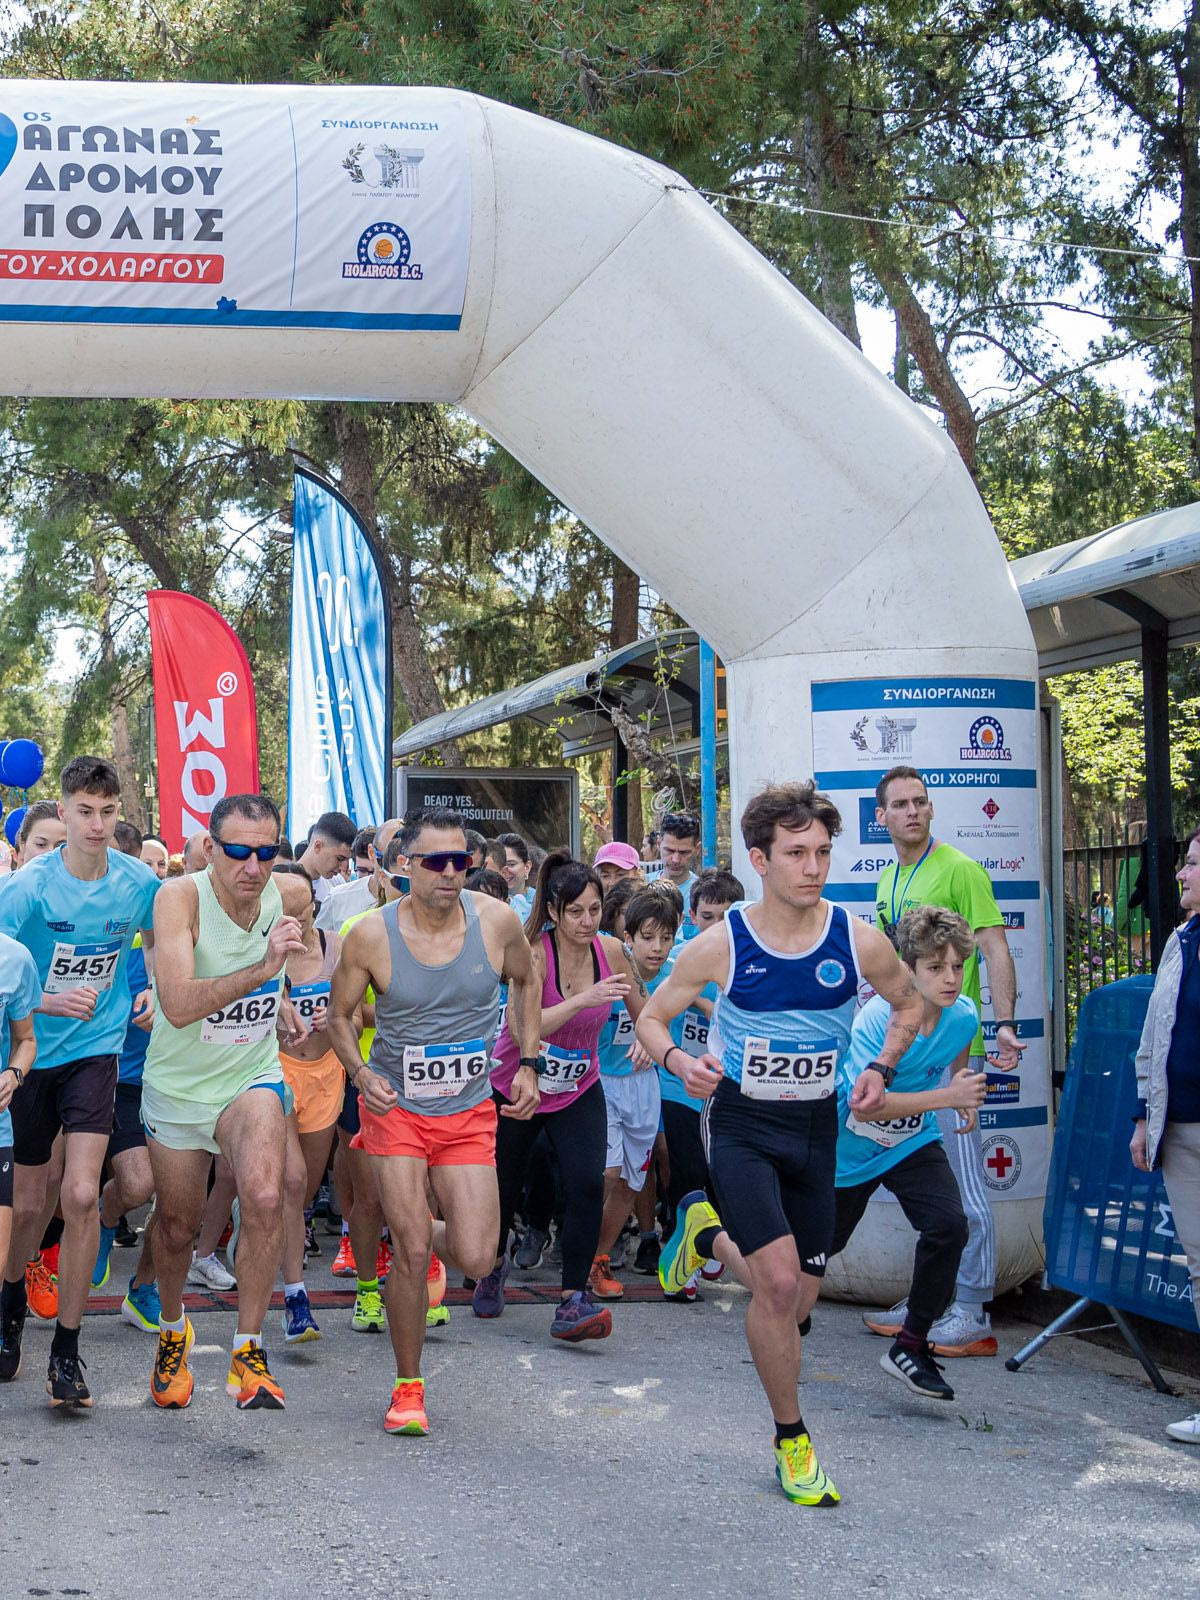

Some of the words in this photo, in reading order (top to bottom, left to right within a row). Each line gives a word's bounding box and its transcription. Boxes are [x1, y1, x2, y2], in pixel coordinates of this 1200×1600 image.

[321, 119, 439, 131] ΣΥΝΔΙΟΡΓΑΝΩΣΗ
[23, 124, 223, 156] ΑΓΩΝΑΣ
[24, 161, 223, 196] ΔΡΟΜΟΥ
[23, 204, 223, 242] ΠΟΛΗΣ
[343, 264, 399, 278] HOLARGOS
[400, 265, 422, 279] B.C.
[883, 688, 995, 700] ΣΥΝΔΙΟΡΓΑΝΩΣΗ
[961, 748, 999, 759] HOLARGOS
[948, 773, 1000, 784] ΧΟΡΗΓΟΙ
[424, 795, 453, 806] DEAD?
[454, 795, 475, 807] YES.
[53, 953, 118, 977] 5457
[684, 1024, 708, 1044] 58
[408, 1056, 484, 1081] 5016
[544, 1059, 587, 1079] 319
[746, 1054, 833, 1079] 5205
[1146, 1273, 1178, 1298] The
